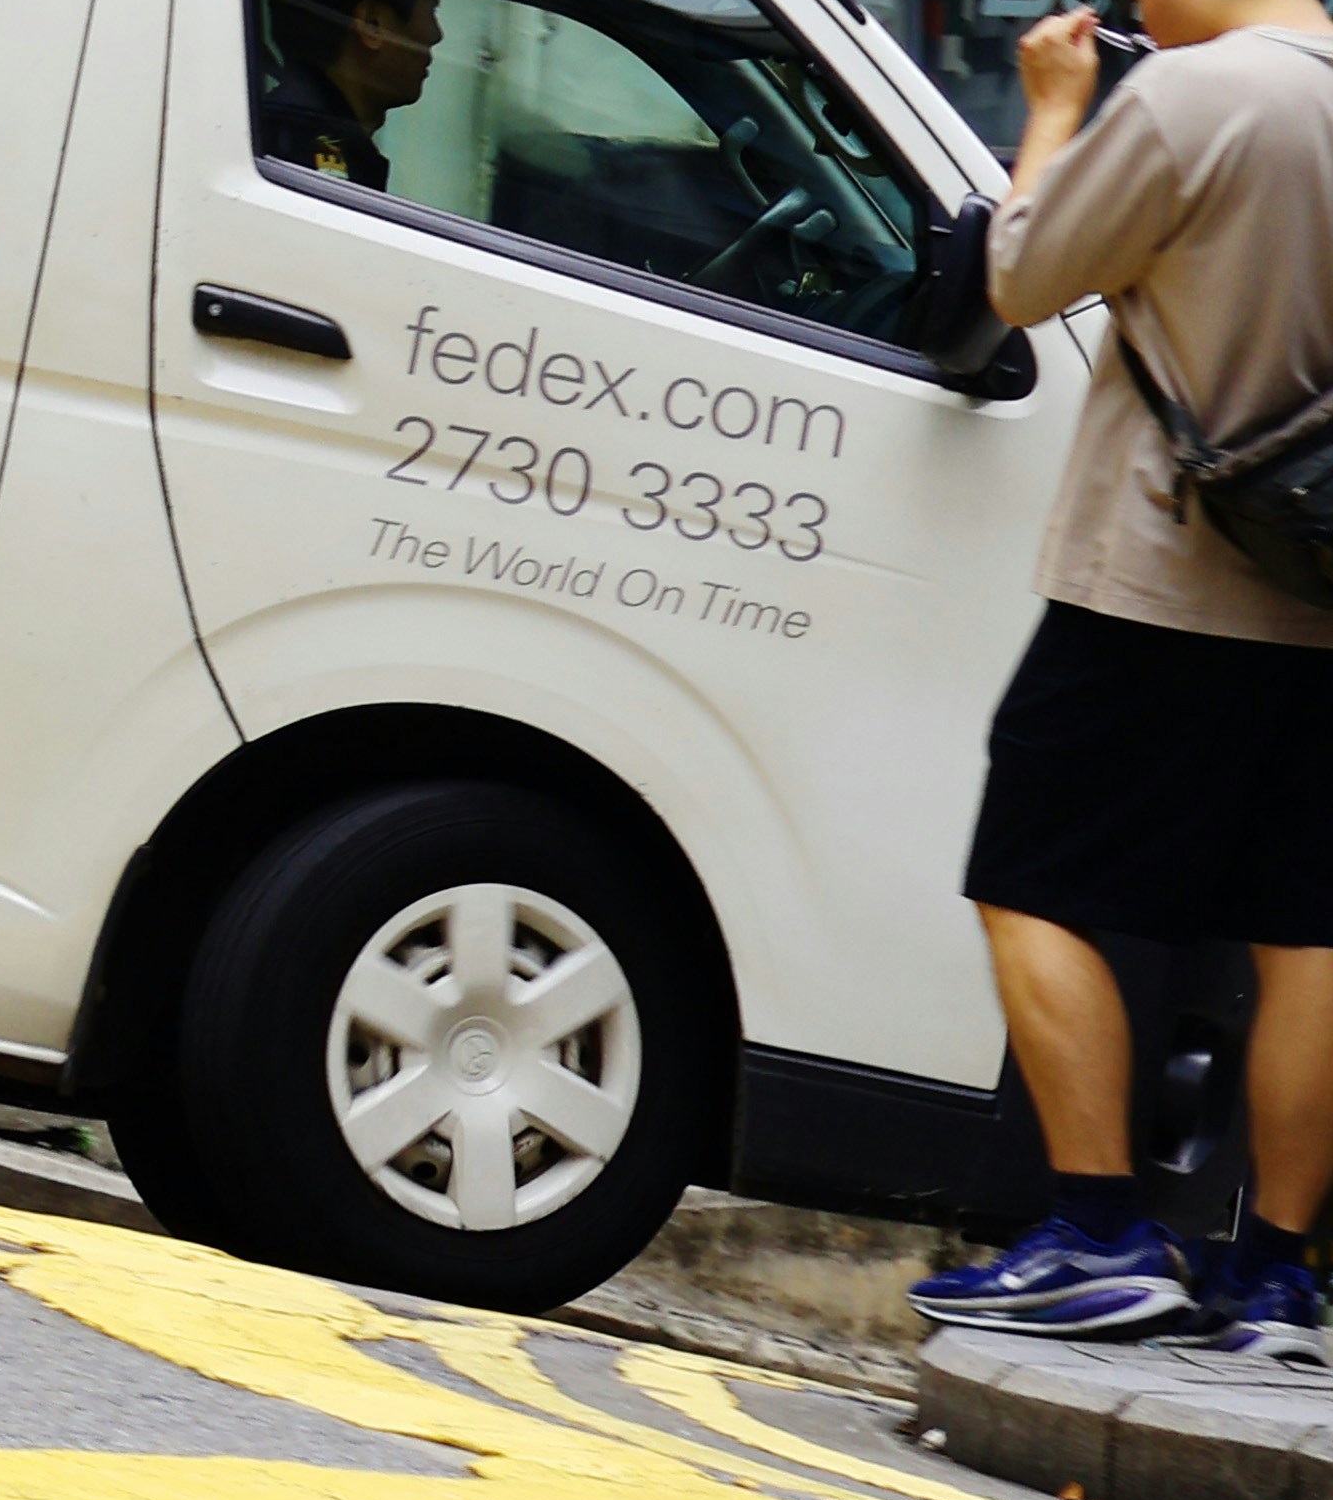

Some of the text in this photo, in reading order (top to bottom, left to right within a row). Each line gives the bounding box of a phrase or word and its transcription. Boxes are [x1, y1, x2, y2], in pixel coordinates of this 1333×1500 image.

[405, 305, 849, 459] fedex.com
[384, 415, 831, 562] 2730 3333
[368, 517, 814, 642] The World On Time
